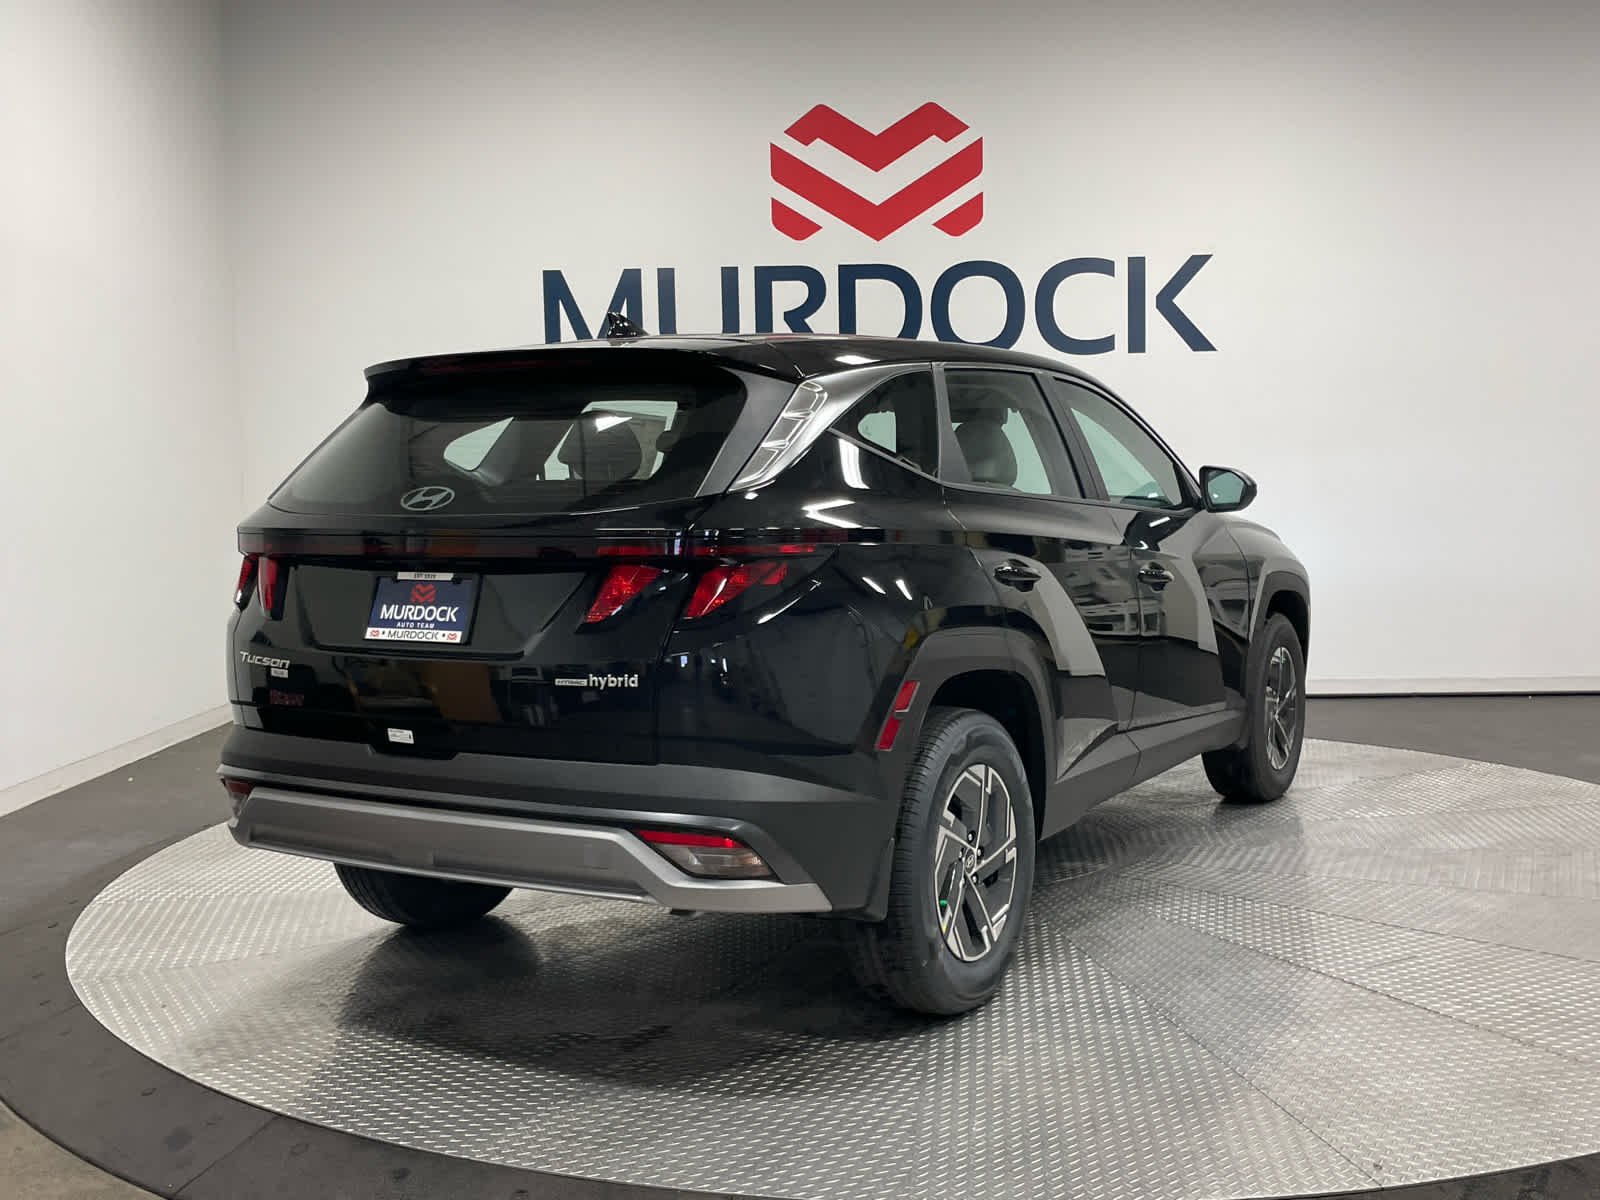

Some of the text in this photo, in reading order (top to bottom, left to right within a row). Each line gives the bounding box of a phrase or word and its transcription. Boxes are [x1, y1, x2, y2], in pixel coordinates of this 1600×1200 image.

[542, 253, 1218, 355] MURDOCK
[380, 604, 460, 622] MURDOCK
[387, 629, 439, 640] MURDOCK
[588, 673, 639, 690] hybrid
